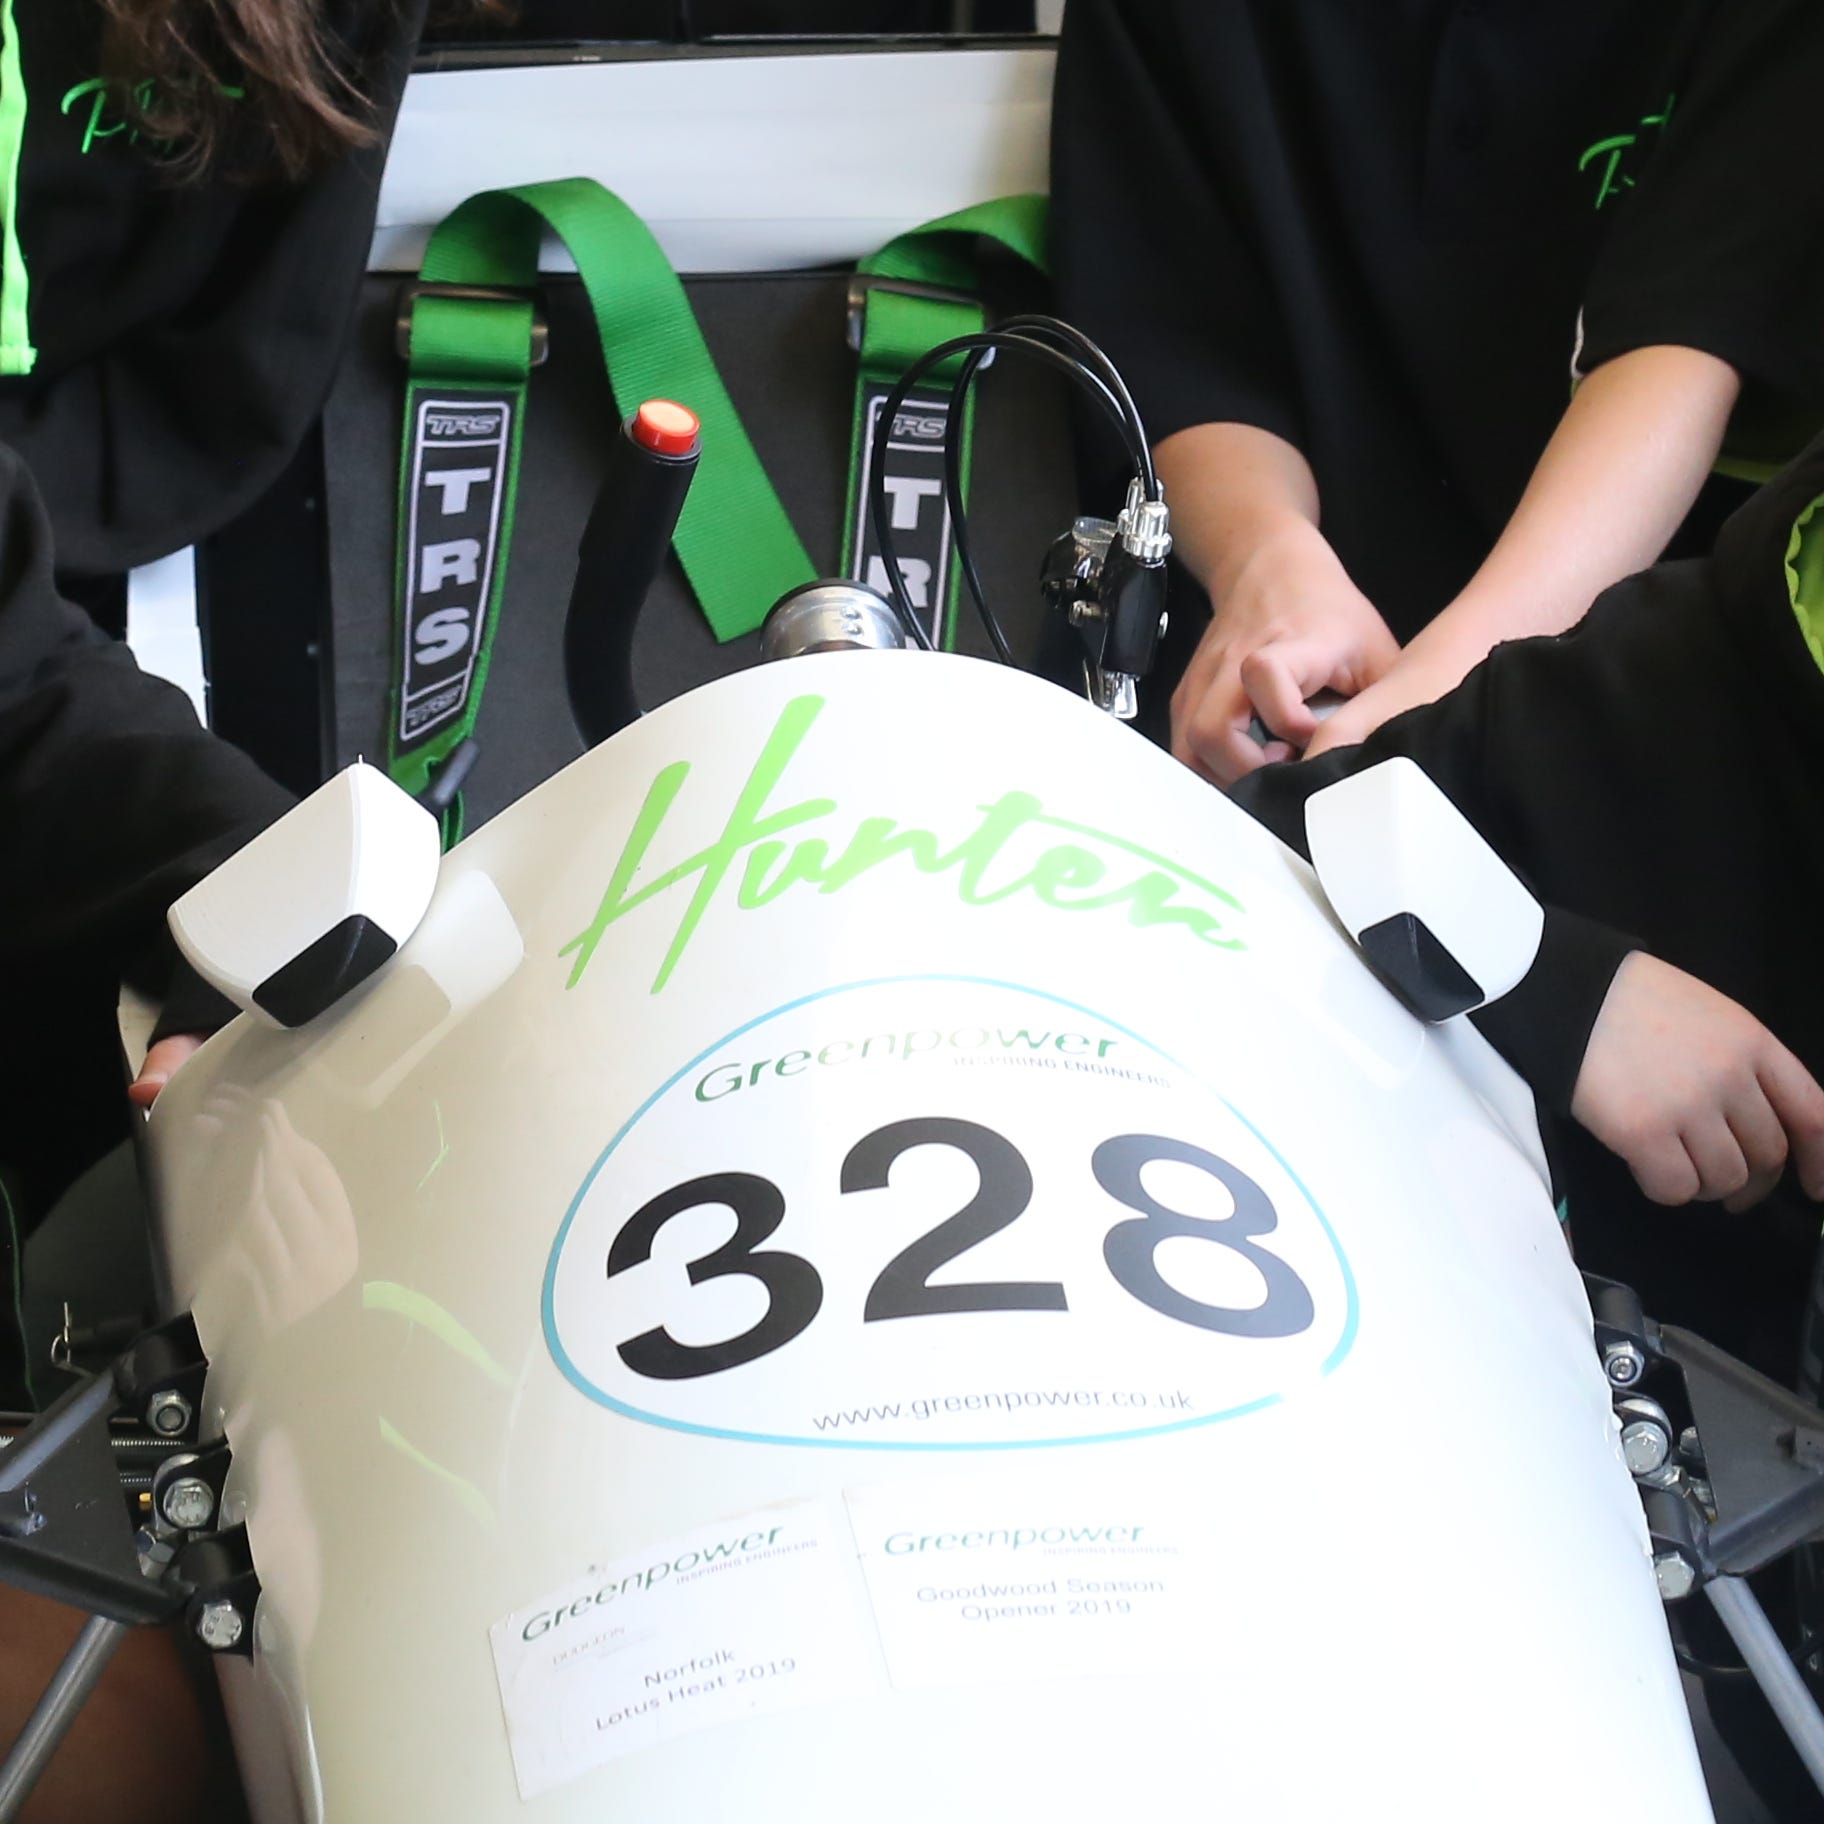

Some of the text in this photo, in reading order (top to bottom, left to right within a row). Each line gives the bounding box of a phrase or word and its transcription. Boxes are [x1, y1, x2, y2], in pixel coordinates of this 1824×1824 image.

[426, 413, 501, 436] TRS
[414, 467, 492, 666] TRS
[867, 476, 942, 649] TR
[558, 694, 1249, 995] Hunter
[693, 1026, 1118, 1103] Greenpower
[606, 1116, 1315, 1381] 328
[813, 1389, 1196, 1432] www.greenpower.co.uk
[883, 1525, 1145, 1557] Greenpower
[521, 1525, 784, 1644] Greenpower
[915, 1577, 1165, 1603] Goodwood Season
[960, 1598, 1132, 1623] Opener 2019
[595, 1656, 797, 1731] Lotus Heat 2019
[643, 1648, 736, 1688] Norfolk
